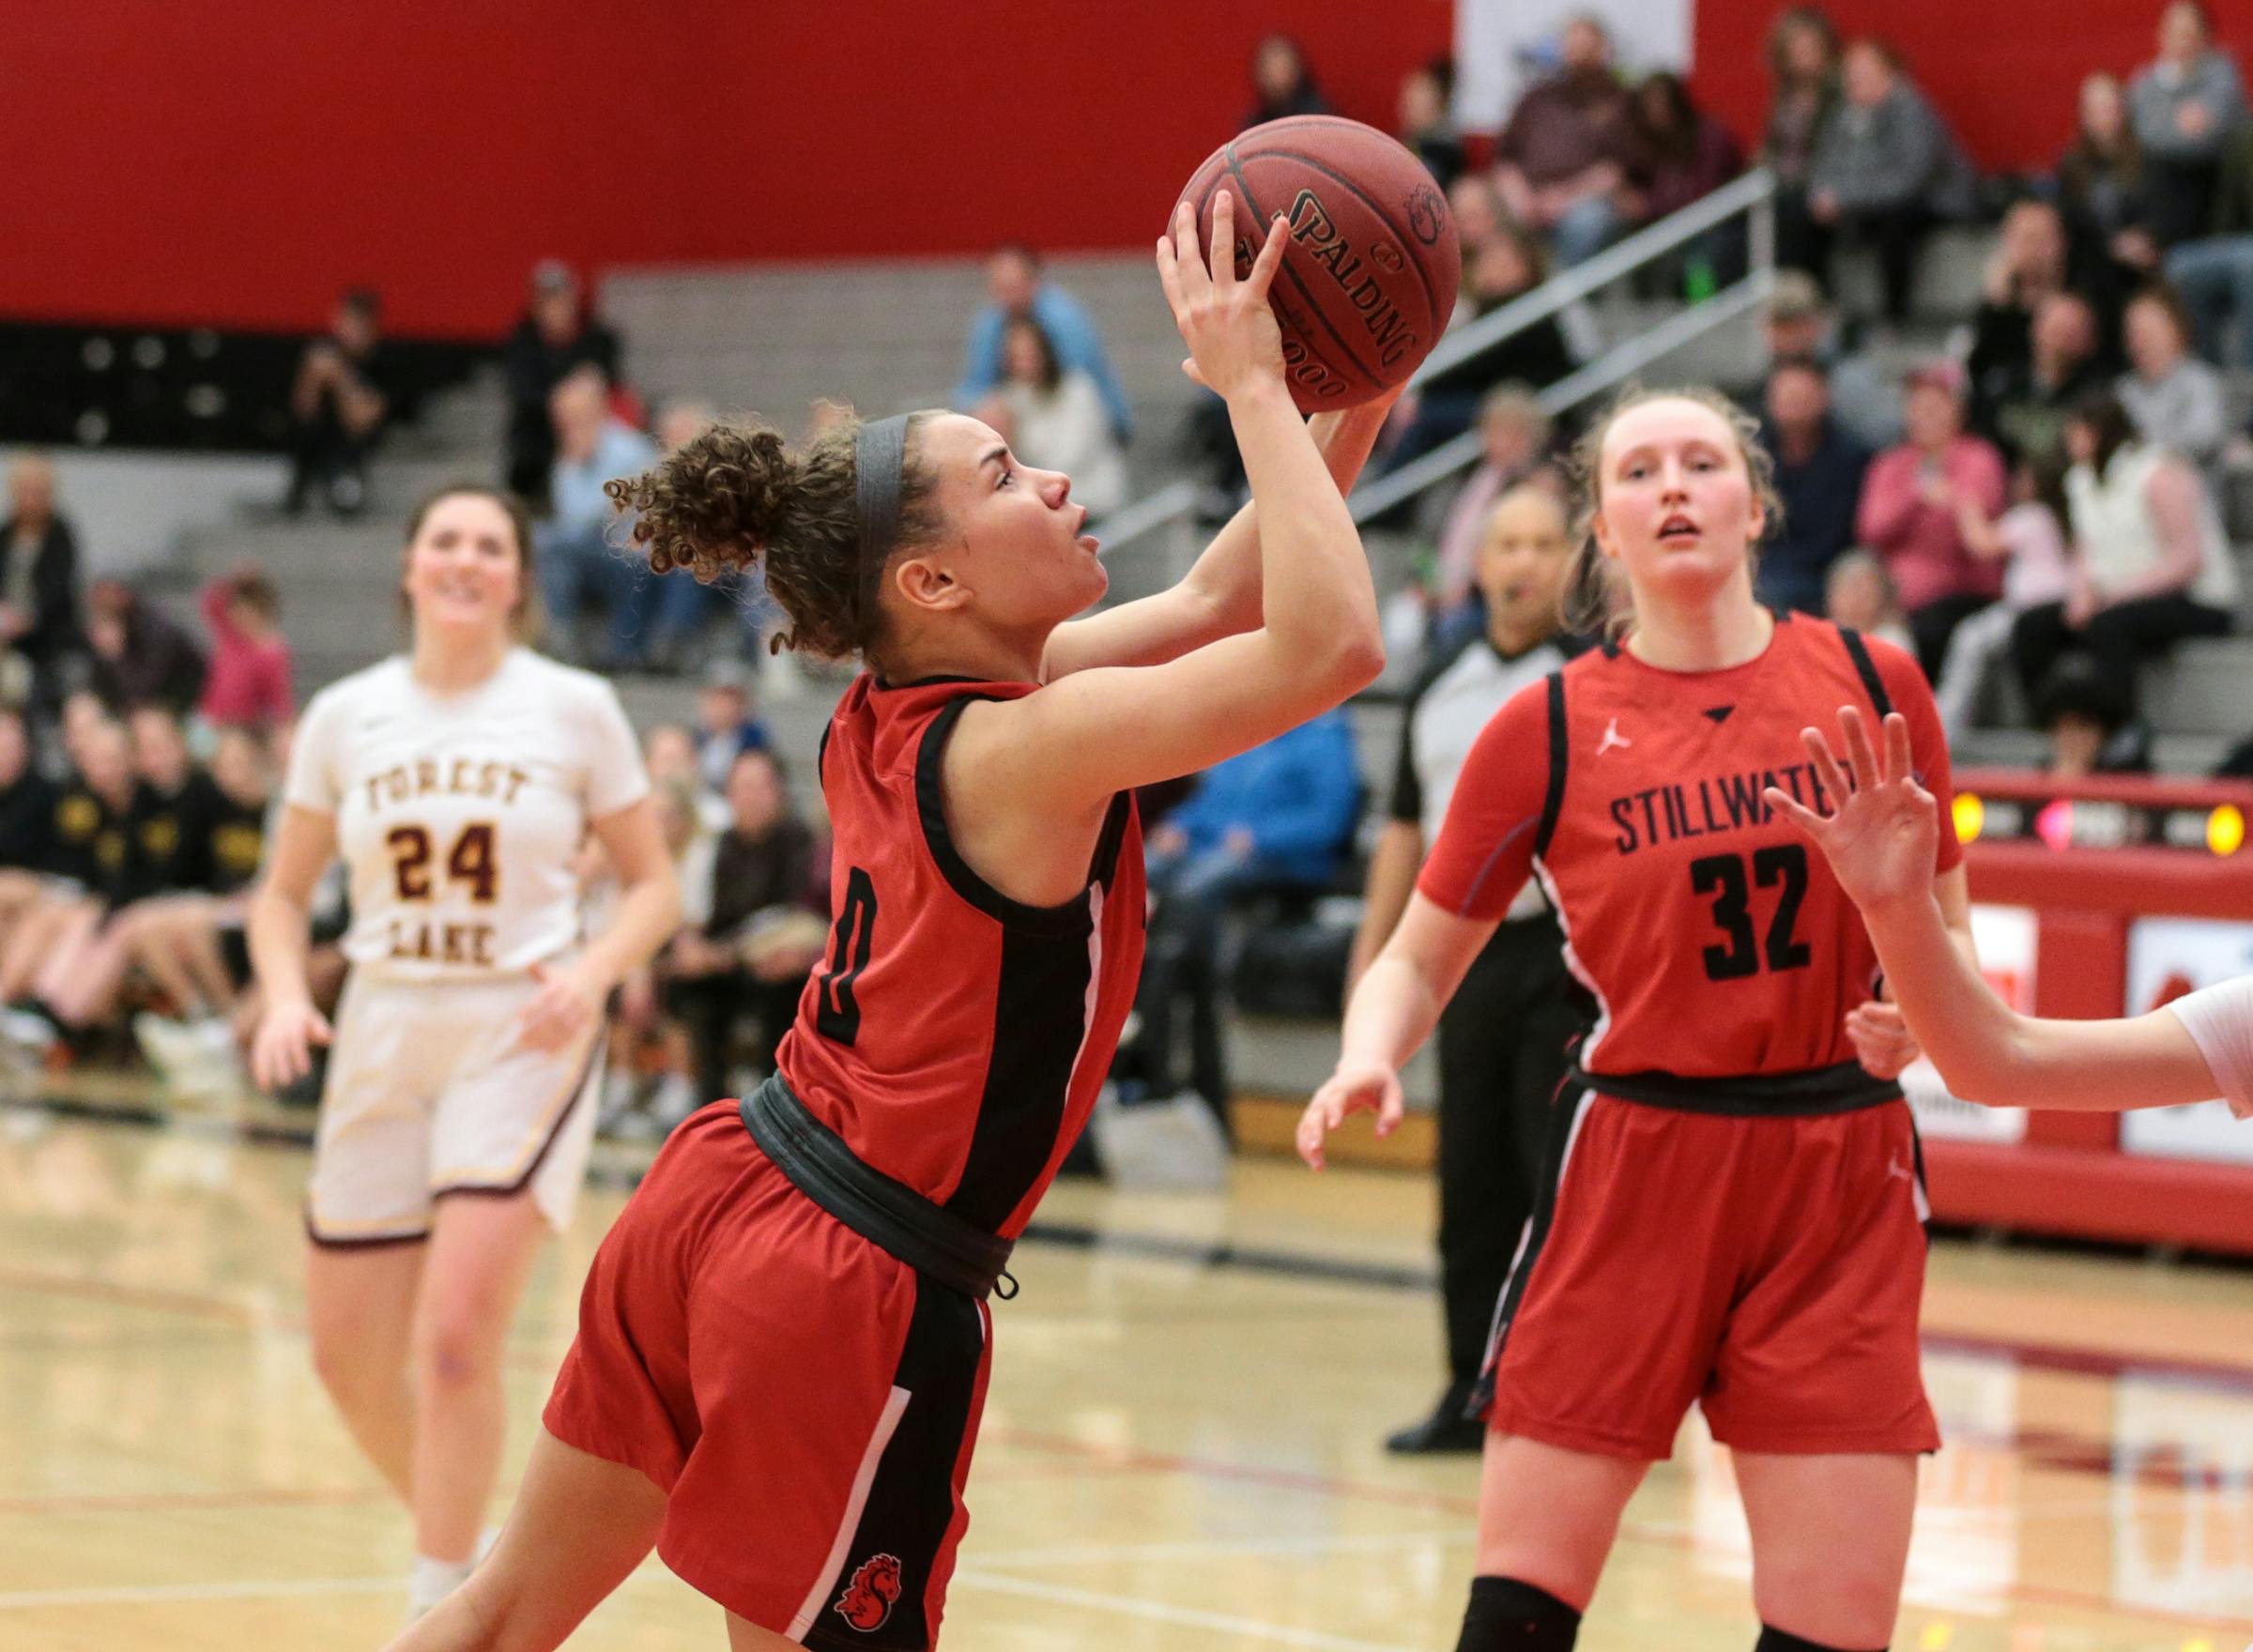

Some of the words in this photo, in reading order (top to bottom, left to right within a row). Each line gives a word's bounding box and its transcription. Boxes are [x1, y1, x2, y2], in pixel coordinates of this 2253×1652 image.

[1271, 189, 1417, 367] SPALDING
[1280, 317, 1348, 399] 000
[367, 755, 528, 815] FOREST
[385, 818, 497, 904] 24
[389, 920, 496, 966] LAKE
[1690, 843, 1811, 982] 32
[817, 865, 878, 1048] 0
